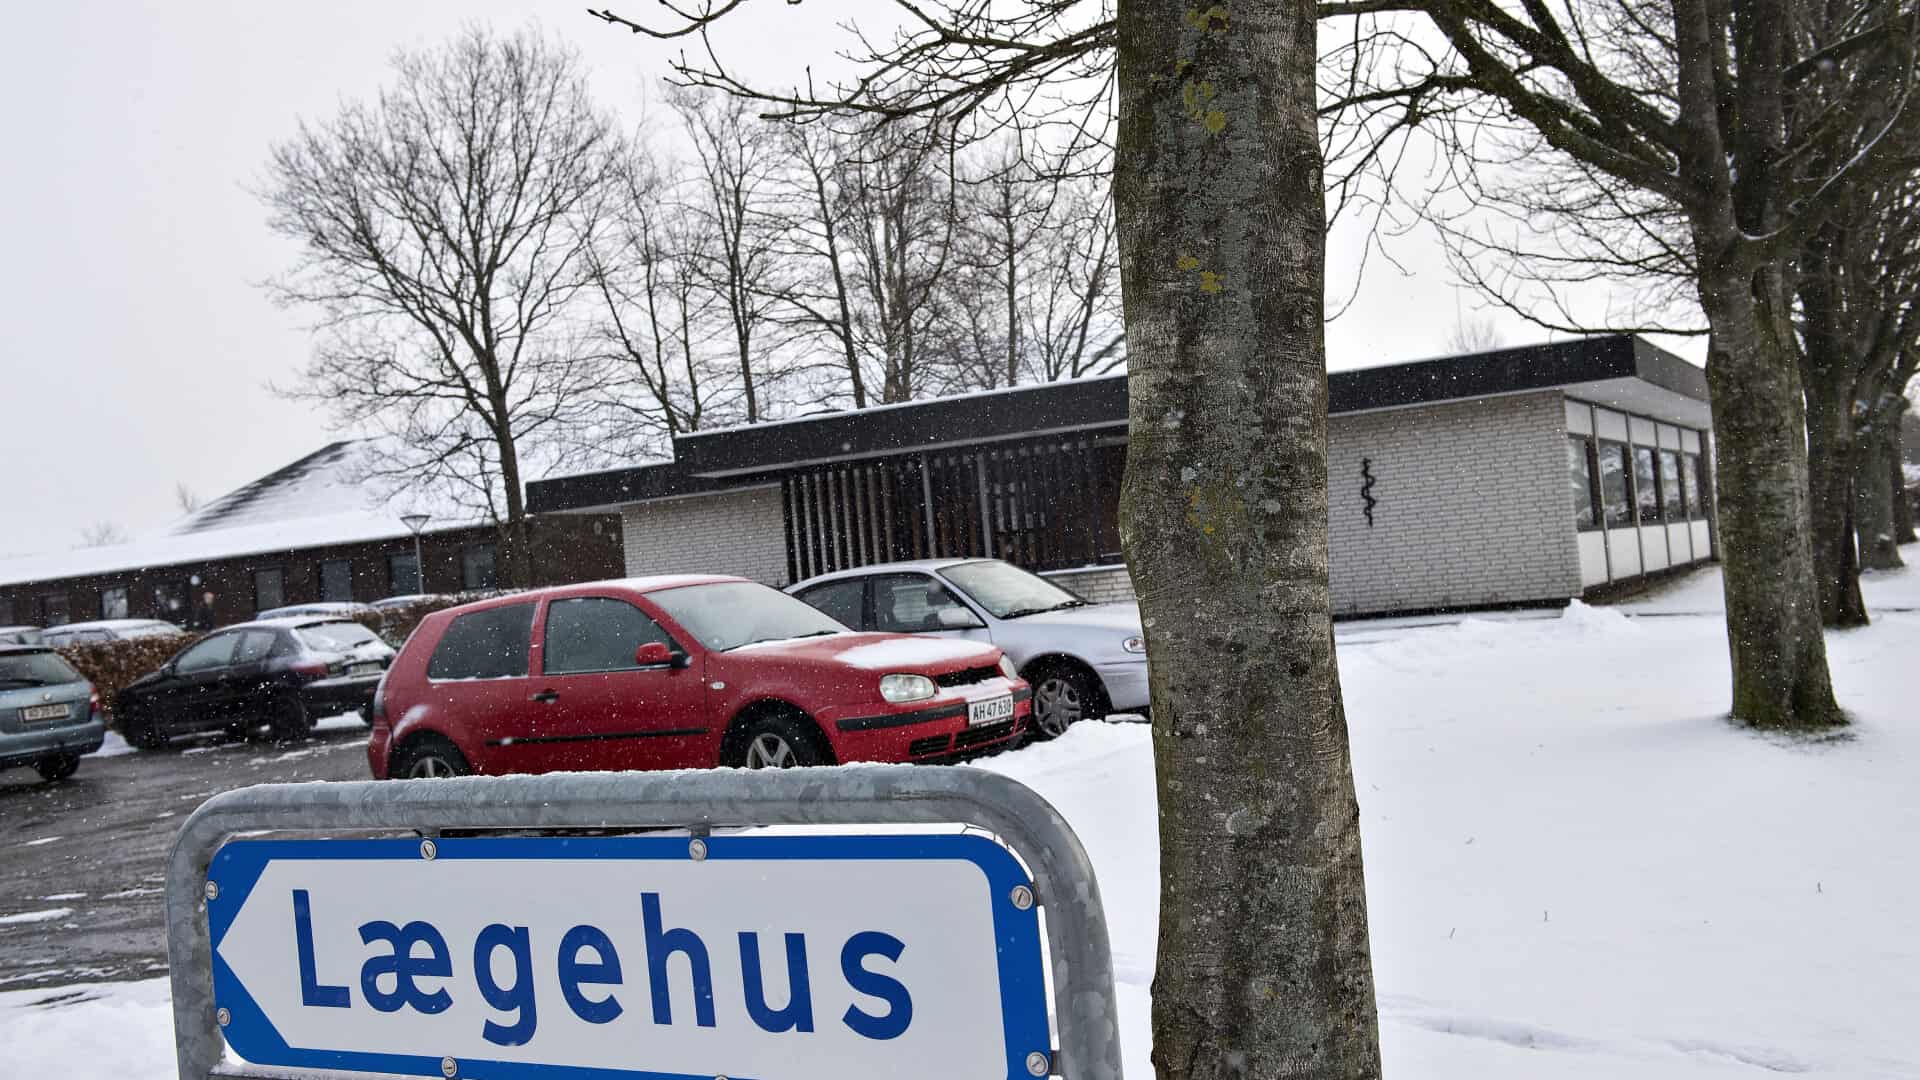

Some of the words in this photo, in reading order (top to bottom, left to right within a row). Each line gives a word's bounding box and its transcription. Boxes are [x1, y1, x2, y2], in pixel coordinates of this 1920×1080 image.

[973, 704, 985, 720] AH
[987, 702, 997, 717] 47
[291, 888, 914, 1047] Lægehus
